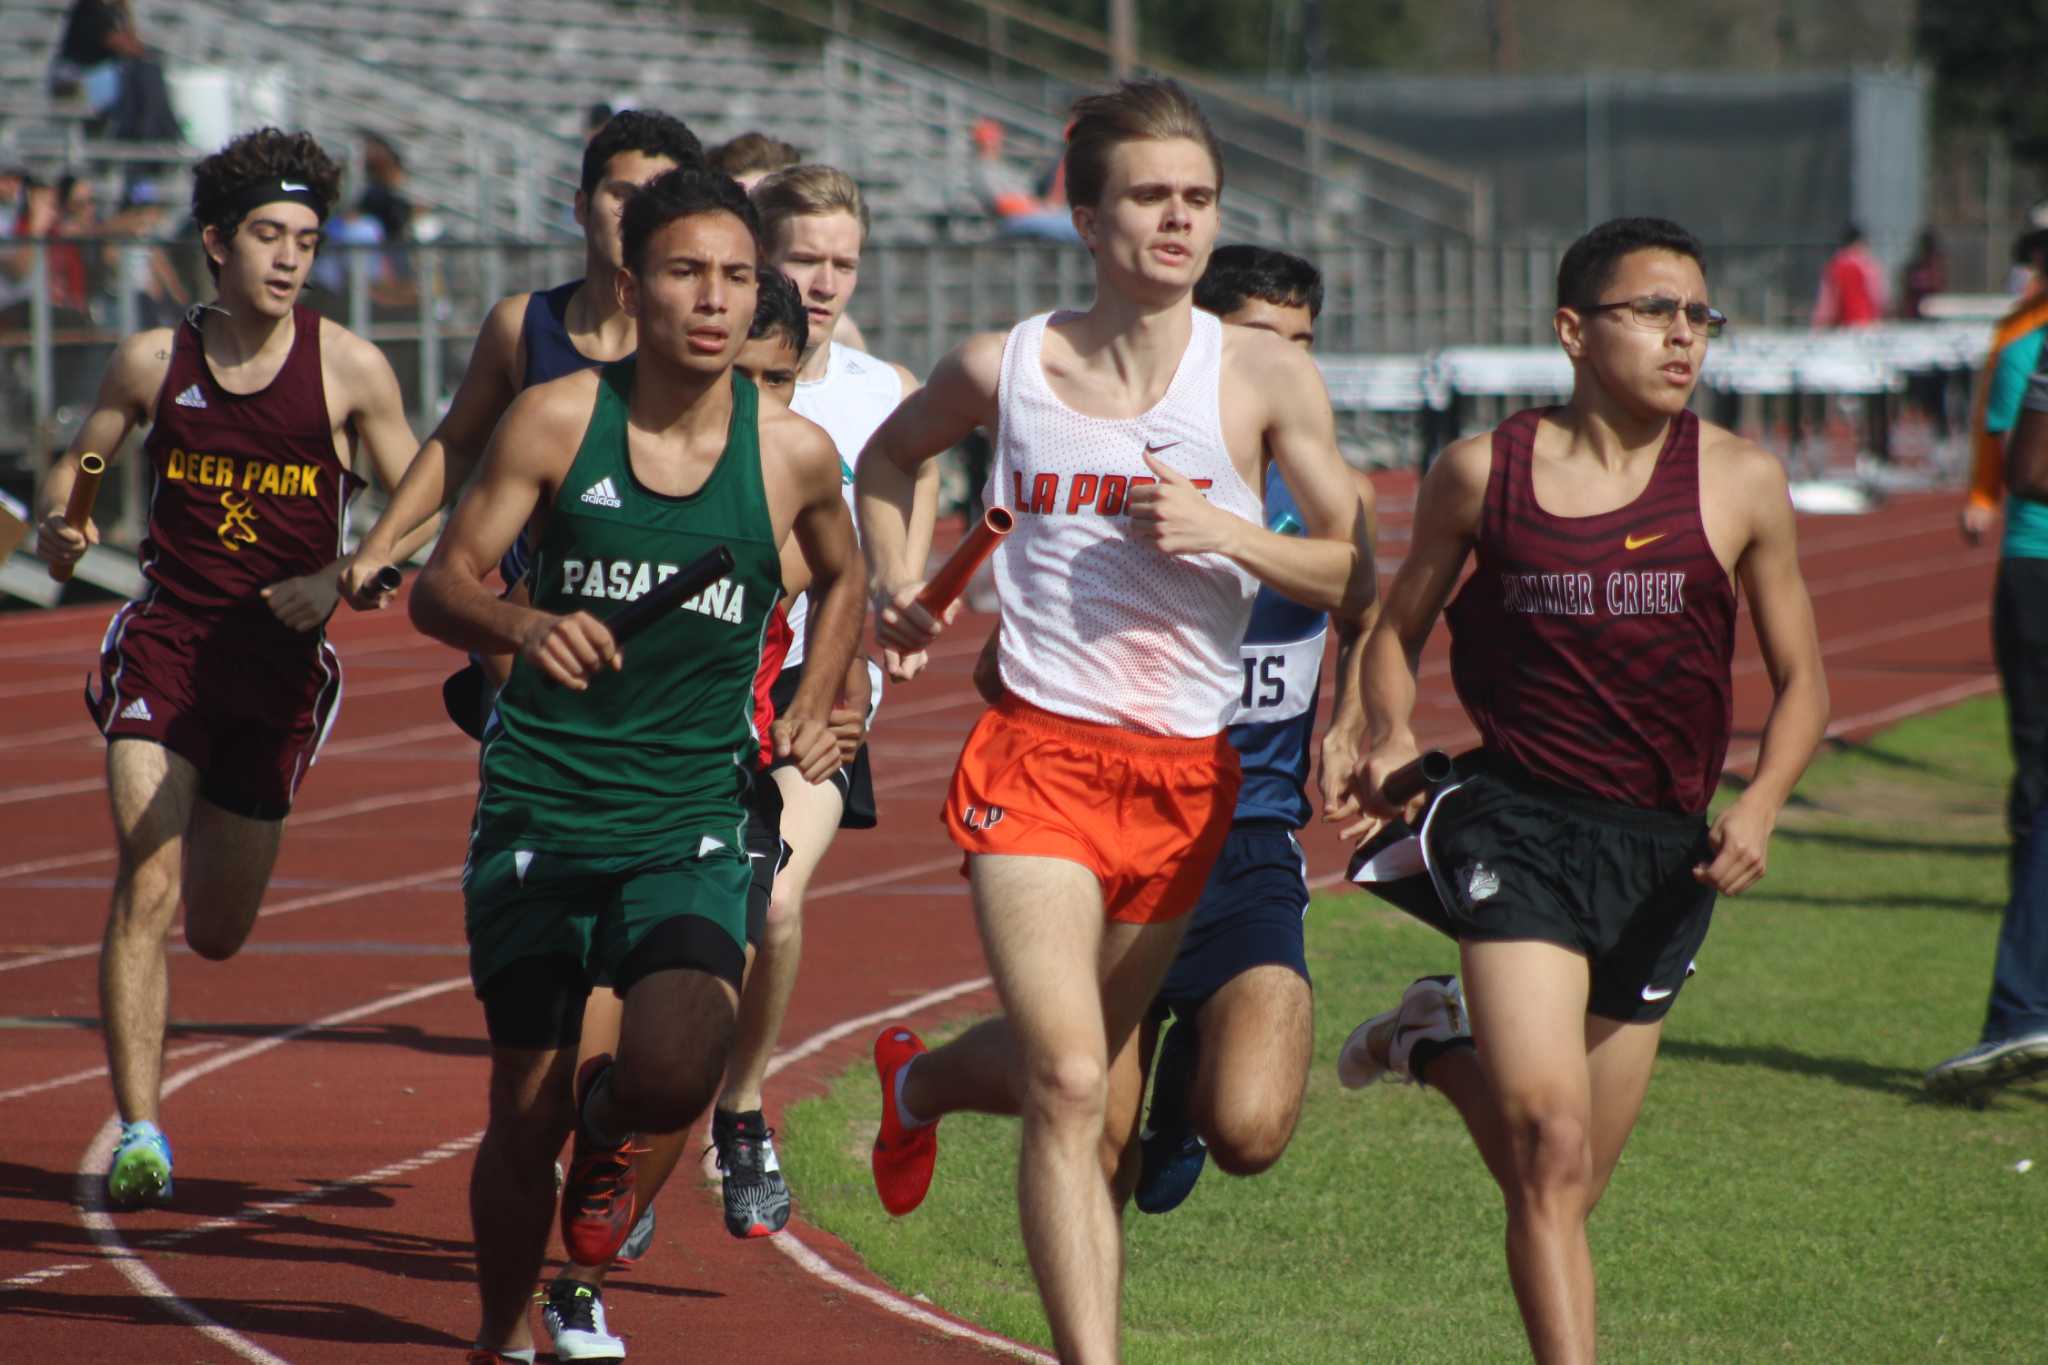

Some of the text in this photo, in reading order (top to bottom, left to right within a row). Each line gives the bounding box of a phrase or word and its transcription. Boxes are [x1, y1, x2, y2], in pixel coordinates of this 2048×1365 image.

[167, 448, 321, 497] DEER PARK
[1013, 470, 1059, 515] LA
[581, 494, 621, 508] adidas
[561, 560, 745, 624] PASANA
[1606, 571, 1686, 616] CREEK
